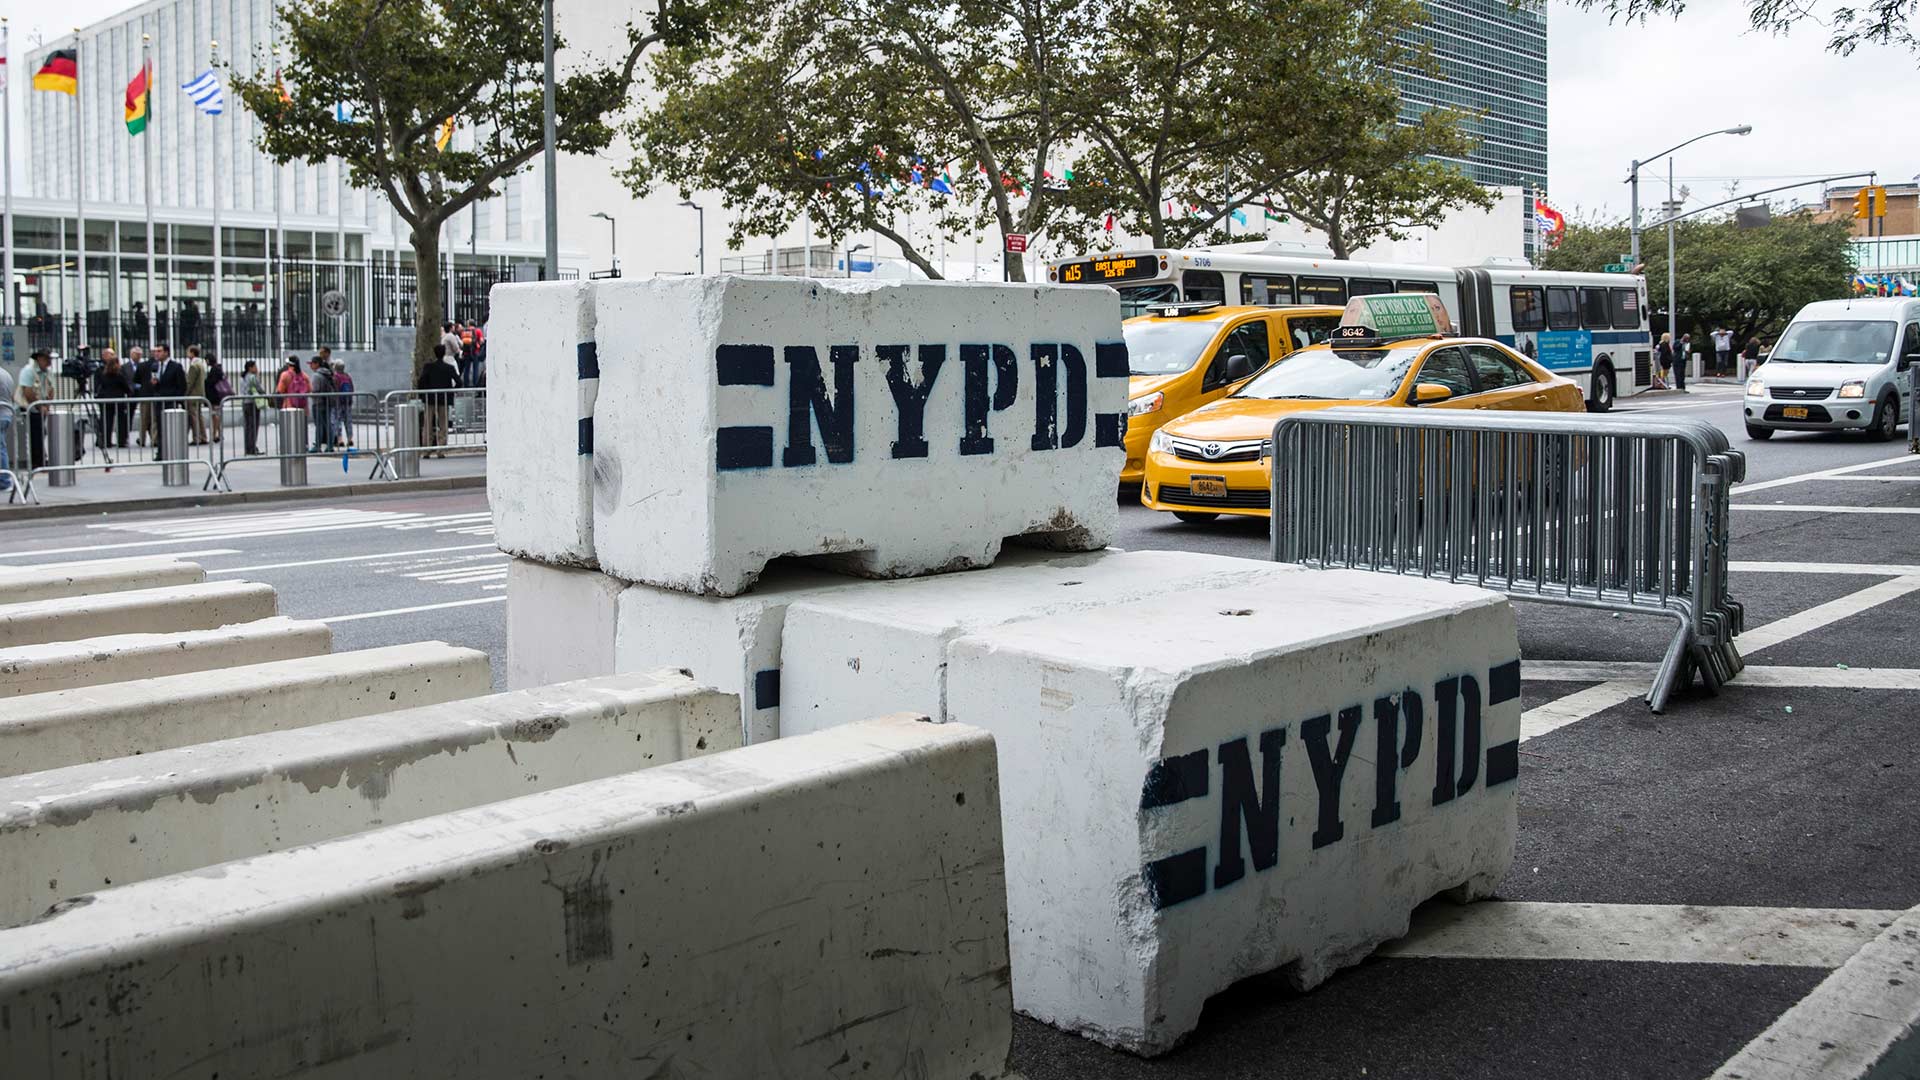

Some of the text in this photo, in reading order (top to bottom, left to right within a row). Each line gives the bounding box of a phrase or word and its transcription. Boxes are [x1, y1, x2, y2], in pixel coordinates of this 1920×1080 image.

[1095, 260, 1111, 272] EAST
[1194, 257, 1212, 267] 5706
[1117, 268, 1126, 277] ST
[1369, 298, 1428, 315] NEW YORK DOLLS
[1375, 313, 1433, 326] GENTLEMEN'S CLUB
[1342, 328, 1364, 337] 8G42
[783, 343, 1089, 467] NYPD
[1214, 675, 1482, 889] NYPD
